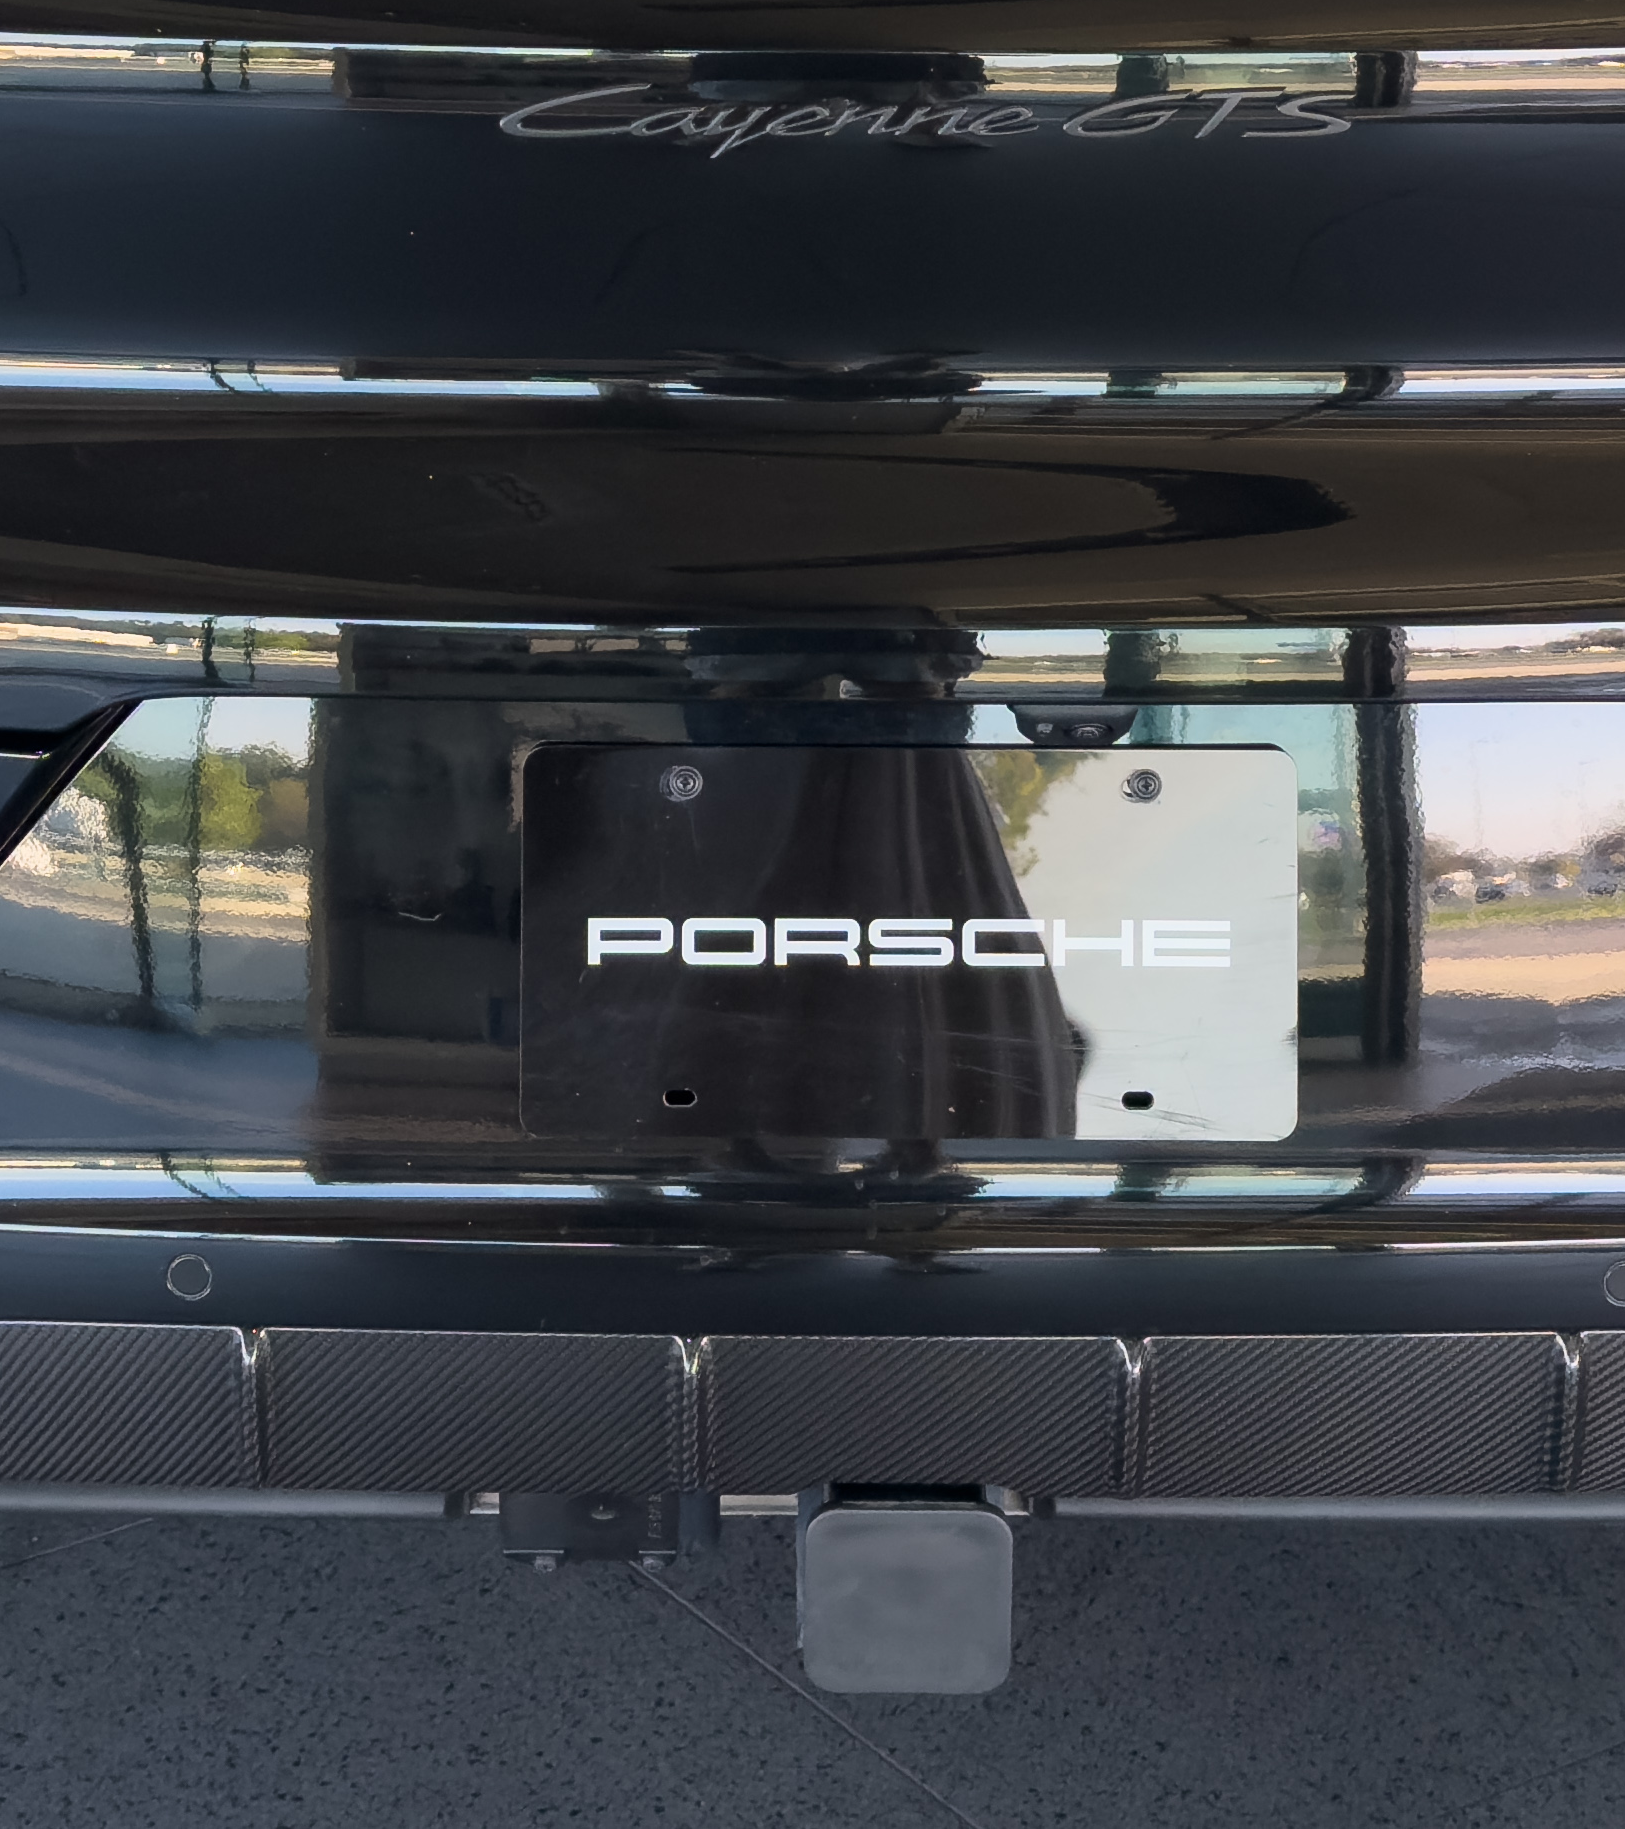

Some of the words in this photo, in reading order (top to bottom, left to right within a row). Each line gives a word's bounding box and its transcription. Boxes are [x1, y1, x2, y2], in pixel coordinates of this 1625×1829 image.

[499, 83, 1039, 159] Cayenne
[1063, 87, 1357, 139] GTS
[586, 917, 1231, 967] PORSCHE
